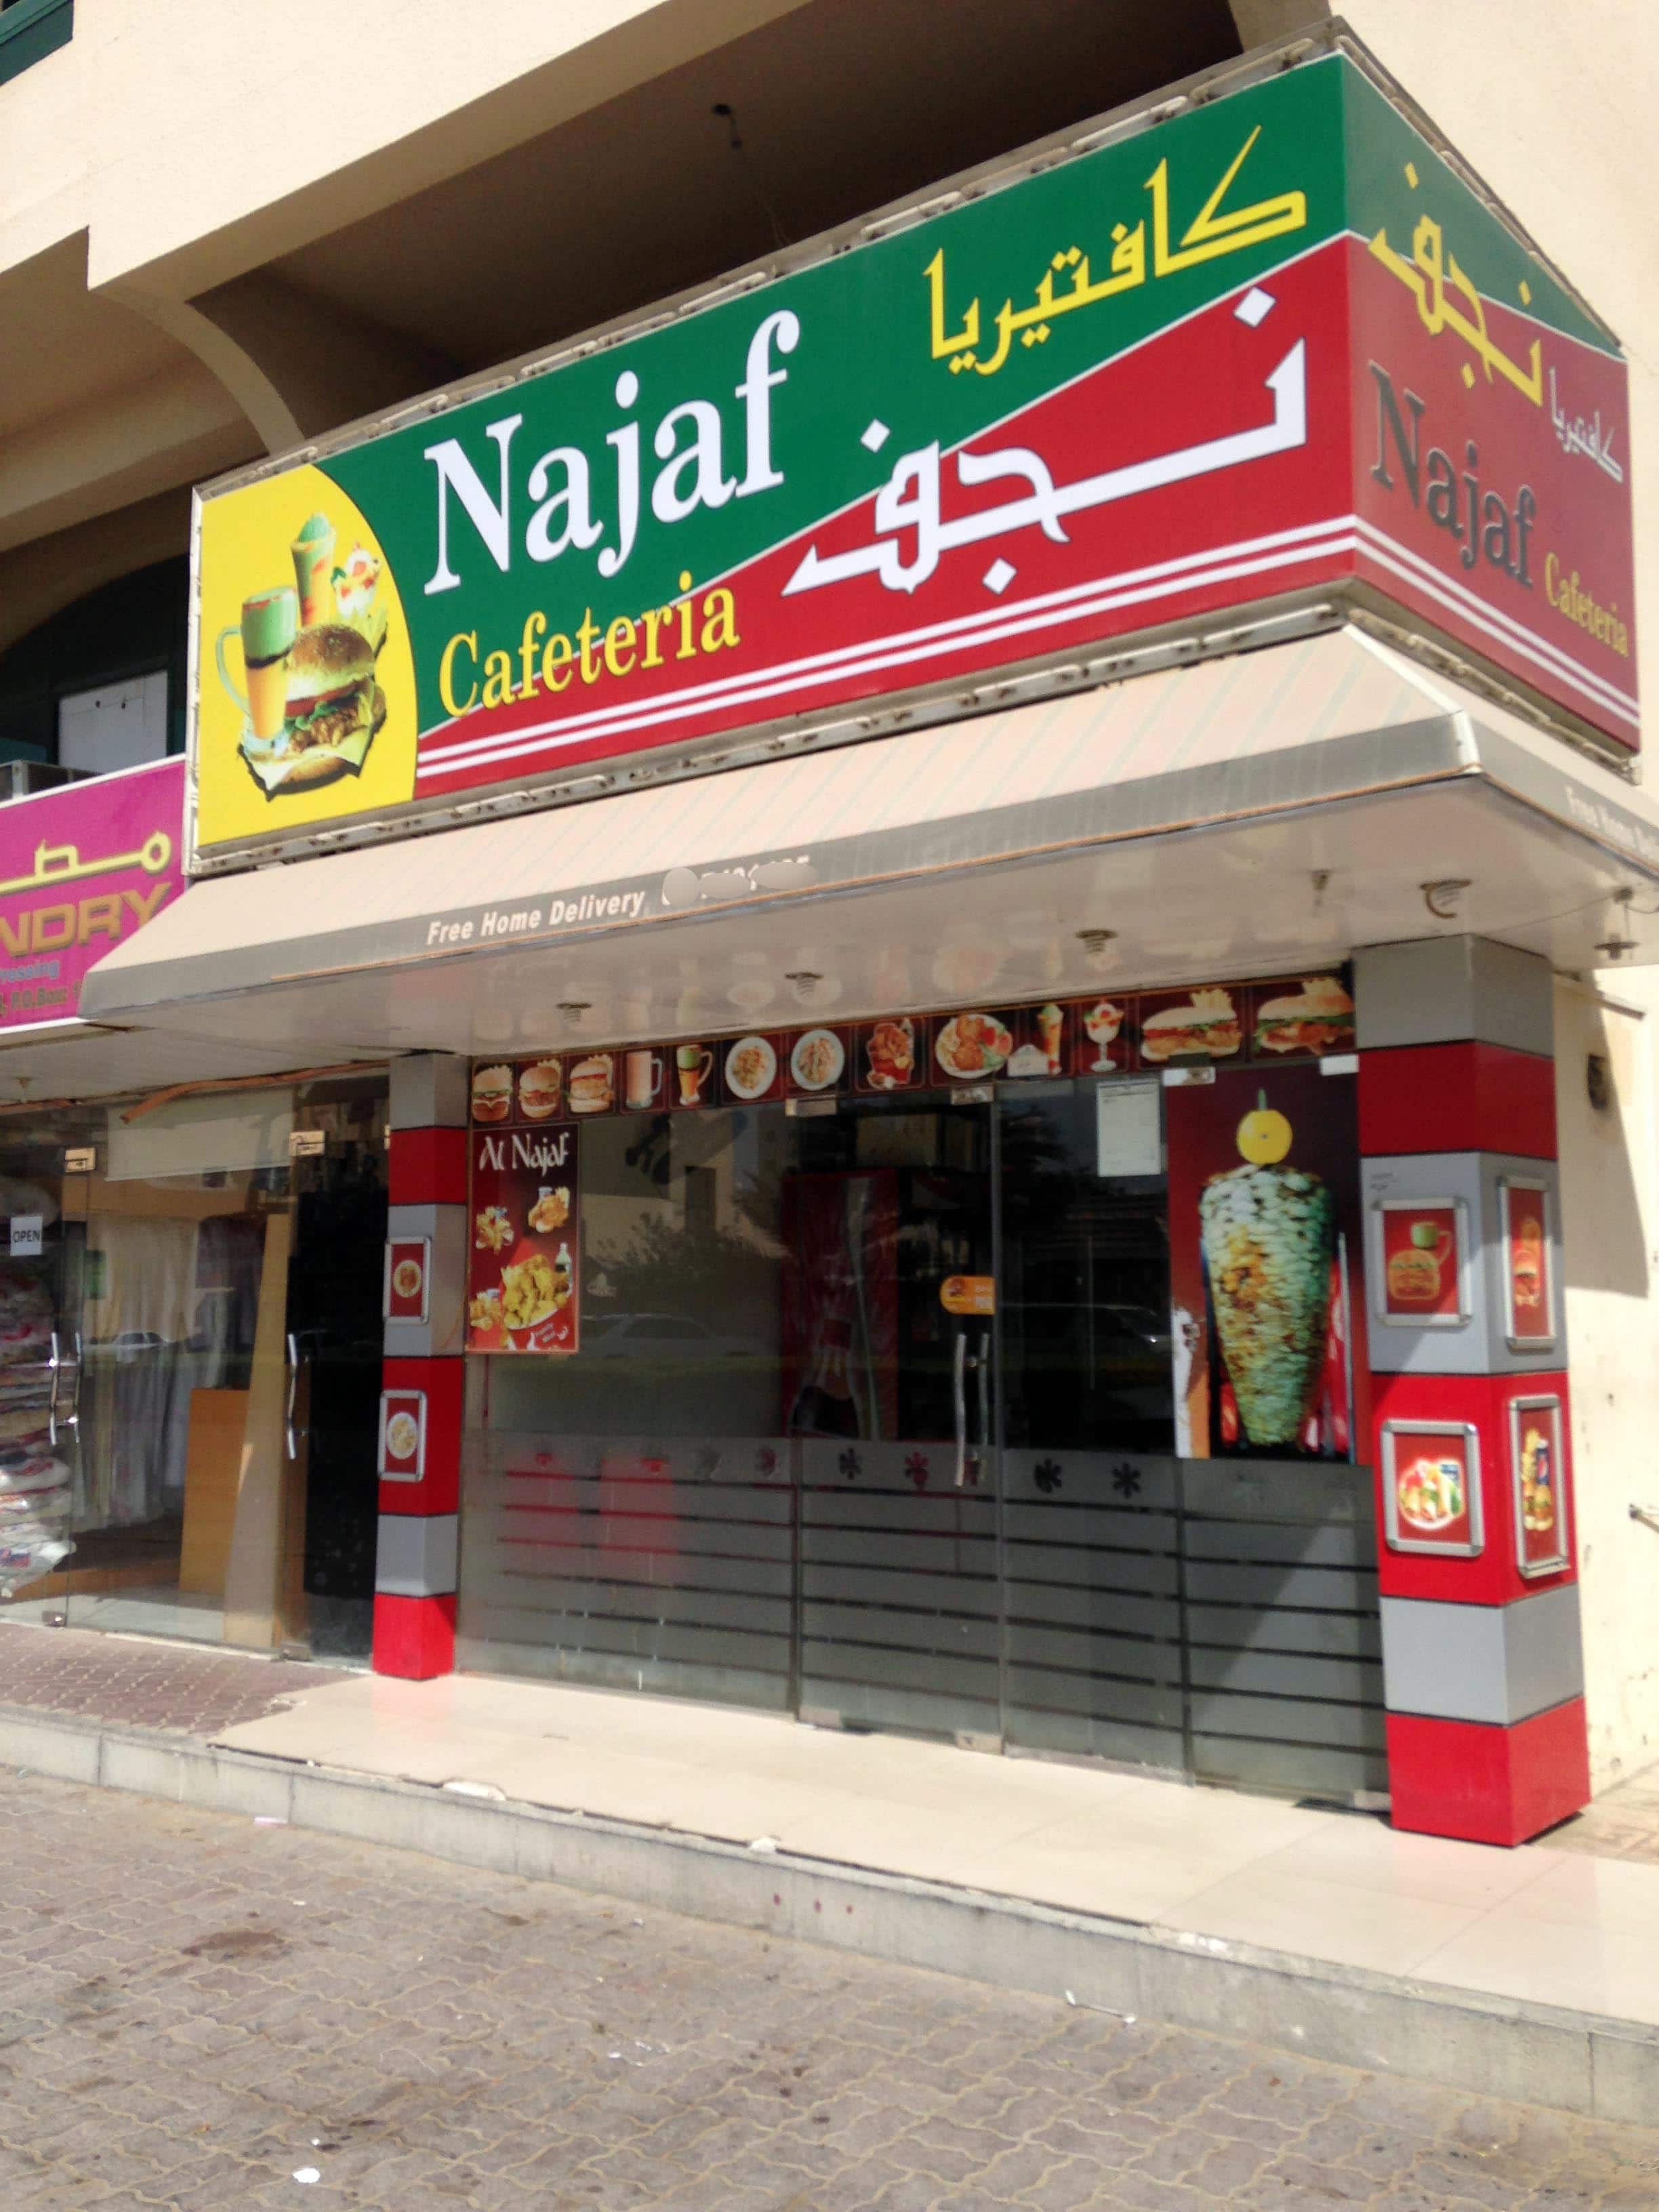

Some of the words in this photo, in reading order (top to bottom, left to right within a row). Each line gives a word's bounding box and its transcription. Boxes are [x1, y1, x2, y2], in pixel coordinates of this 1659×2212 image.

[923, 125, 1307, 375] كافتيريا
[424, 310, 800, 595] Najaf
[781, 286, 1307, 596] نجف
[1368, 359, 1536, 588] Najaf
[439, 571, 741, 717] Cafeteria
[1545, 552, 1629, 657] Cafeteria
[426, 919, 474, 945] Free
[480, 909, 541, 937] Home
[549, 890, 646, 925] Delivery
[478, 1135, 505, 1171] Al
[512, 1132, 569, 1177] Najaf
[14, 1230, 41, 1243] OPEN
